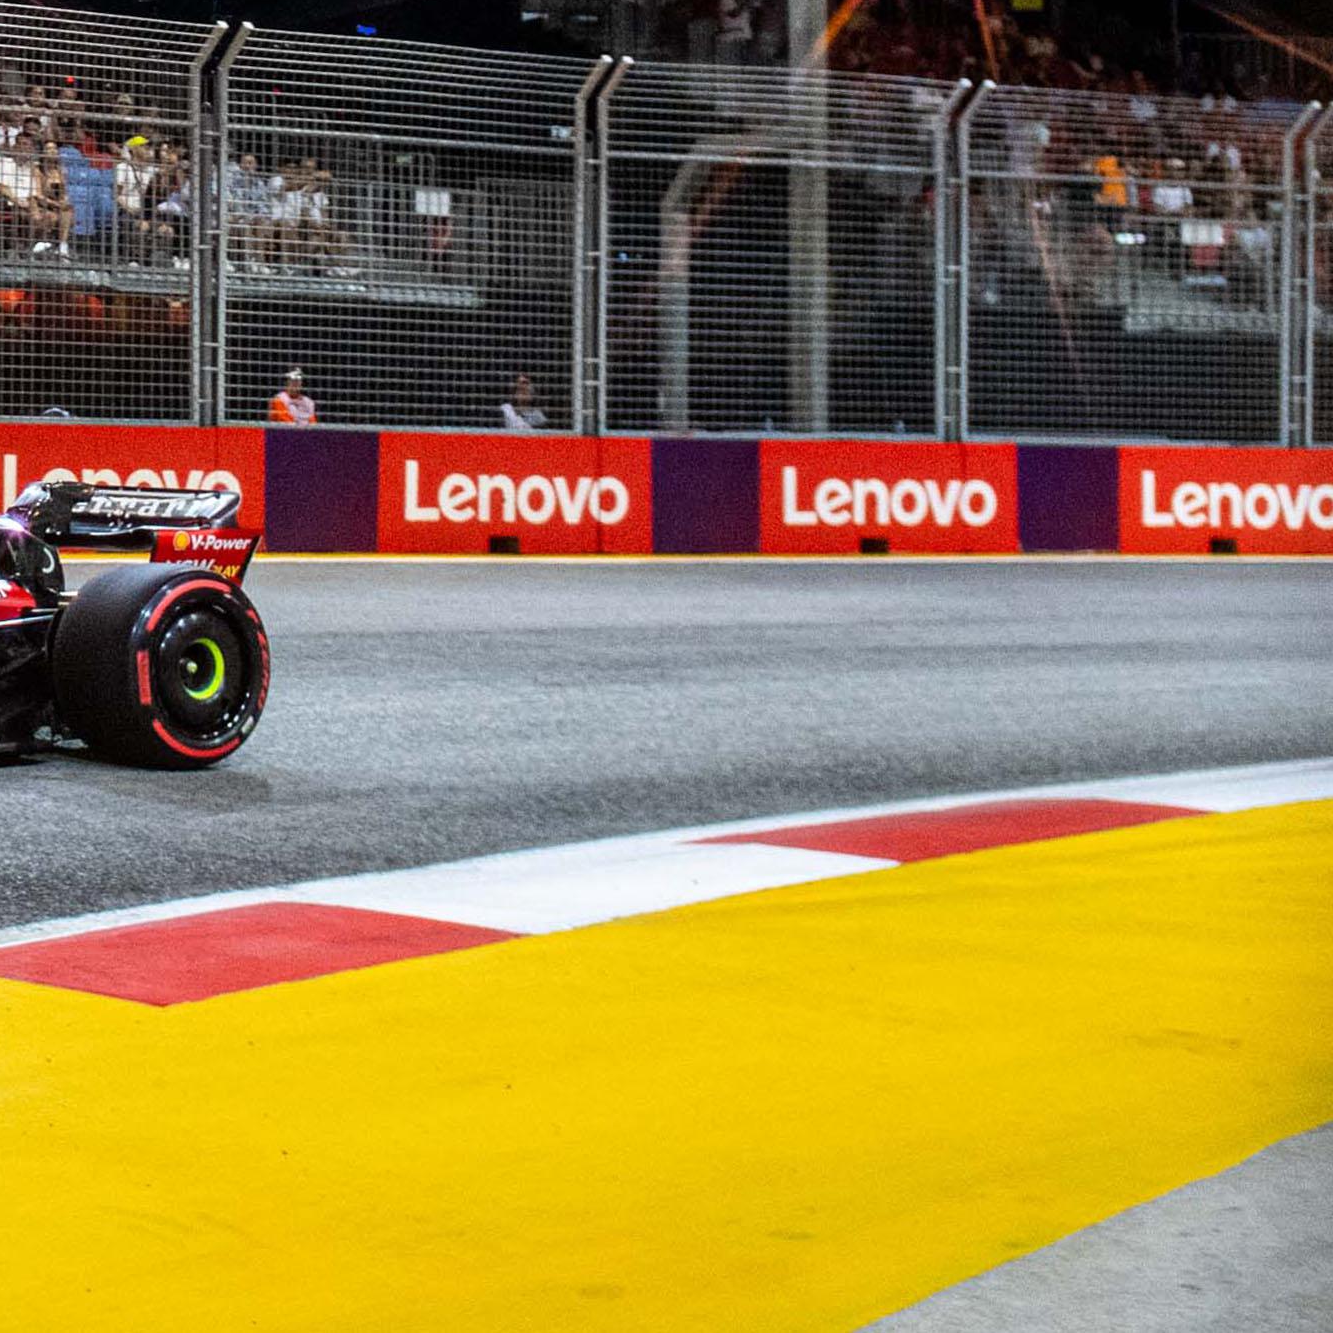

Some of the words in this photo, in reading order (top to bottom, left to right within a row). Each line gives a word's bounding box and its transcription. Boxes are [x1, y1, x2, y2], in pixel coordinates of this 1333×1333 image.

[404, 459, 629, 525] Lenovo
[782, 466, 998, 527] Lenovo
[1141, 469, 1333, 530] Lenovo
[190, 534, 252, 550] V-Power
